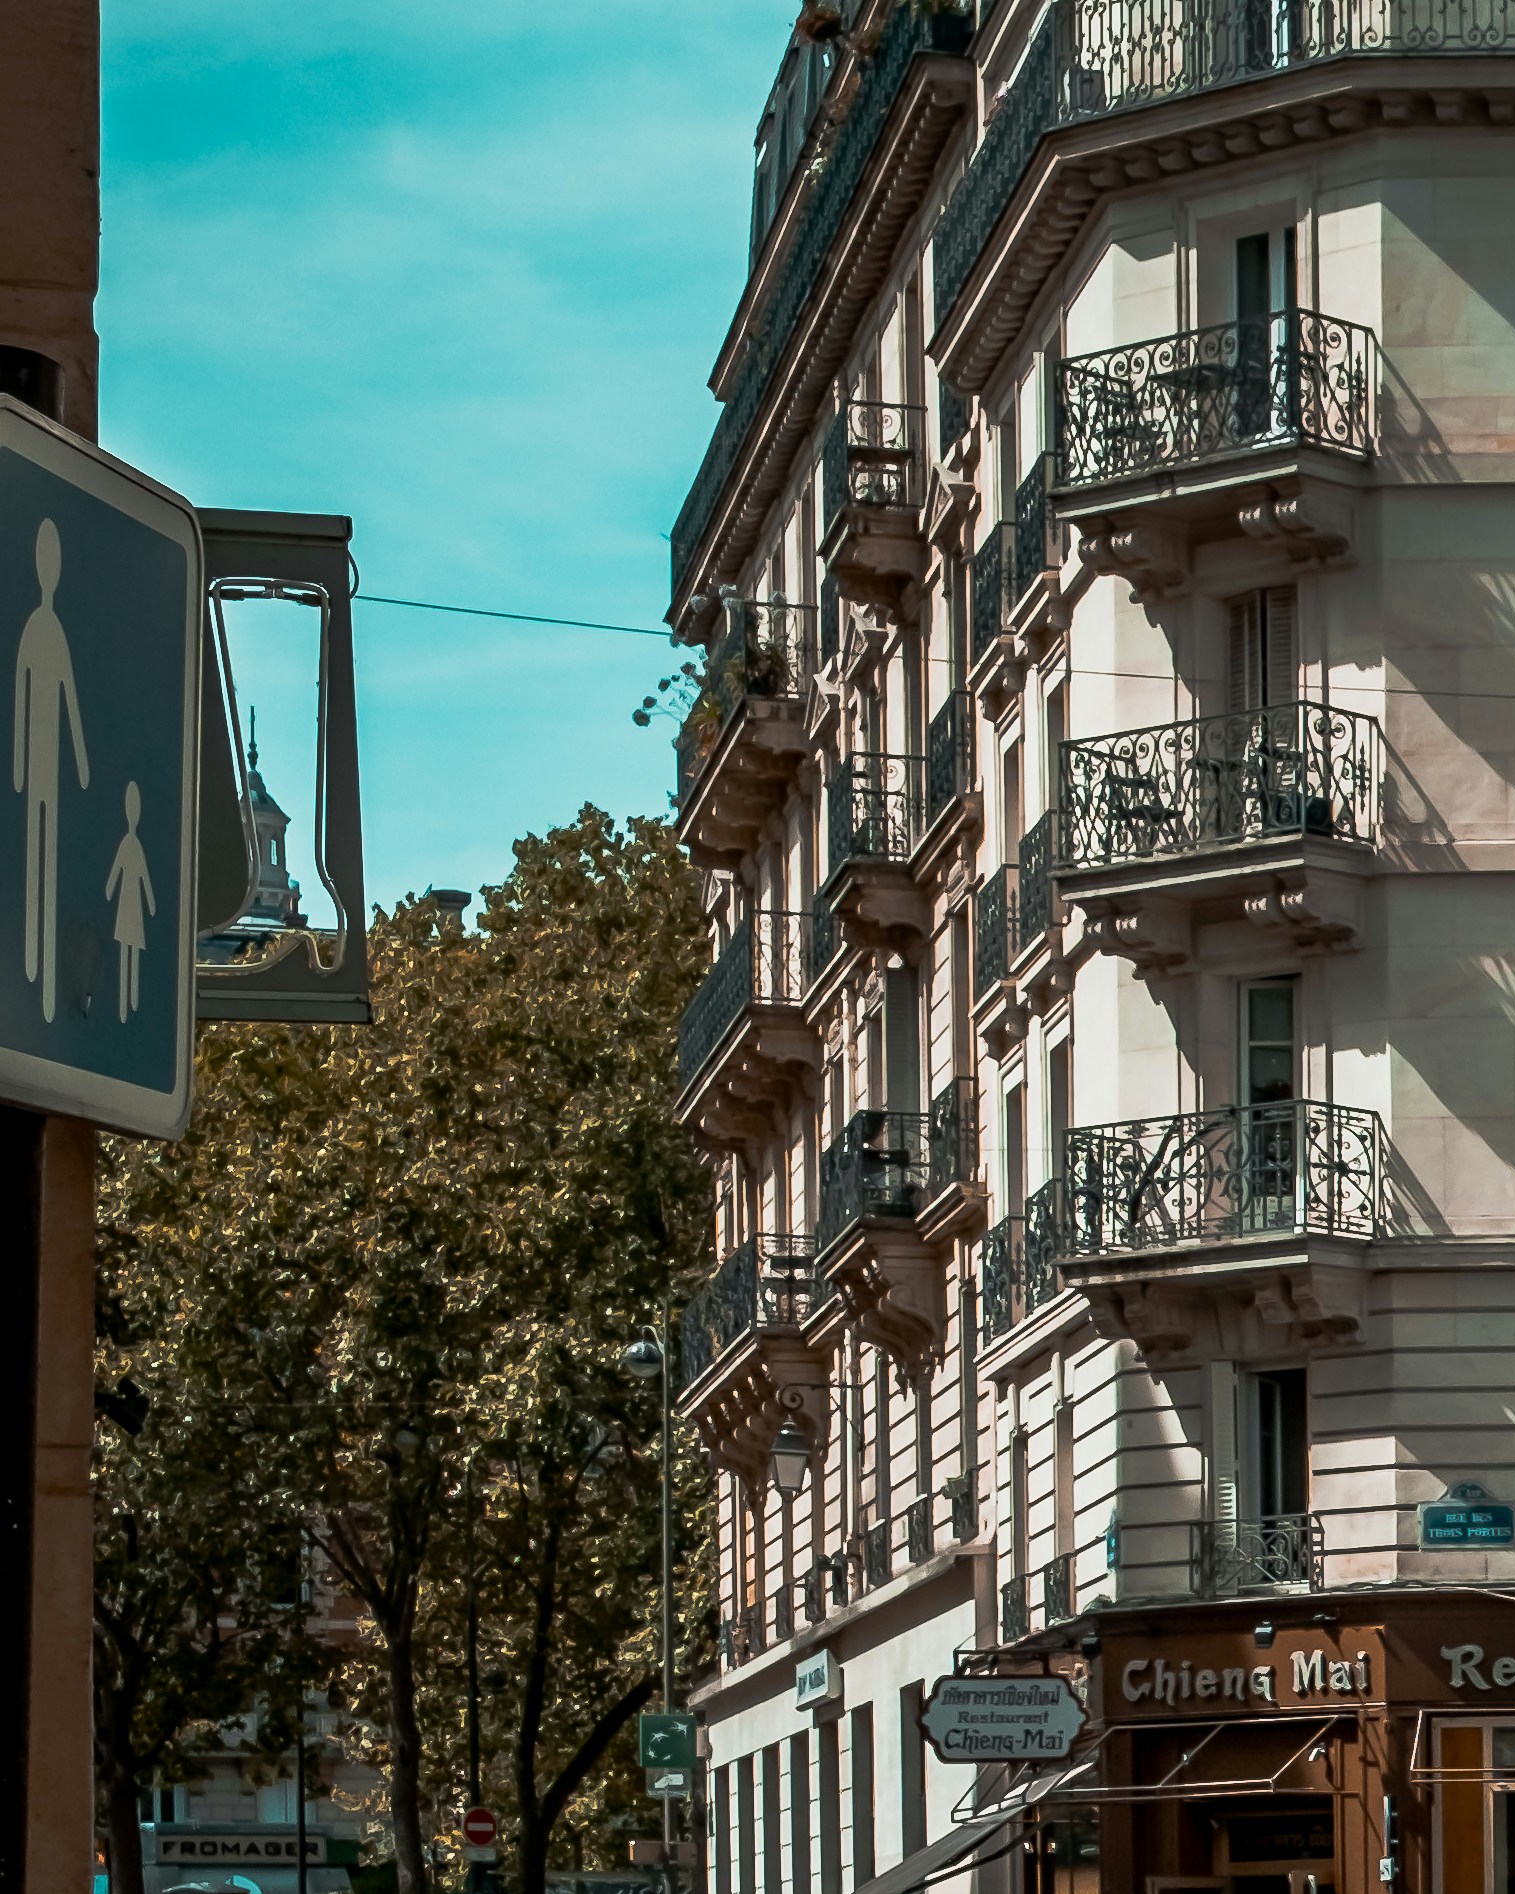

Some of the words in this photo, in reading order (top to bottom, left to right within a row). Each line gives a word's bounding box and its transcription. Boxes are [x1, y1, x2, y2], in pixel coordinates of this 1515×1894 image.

[1121, 1658, 1276, 1706] Chieng
[1289, 1649, 1370, 1694] Mai
[957, 1710, 1049, 1724] Restaurant
[944, 1728, 1064, 1754] Chieng-Mai
